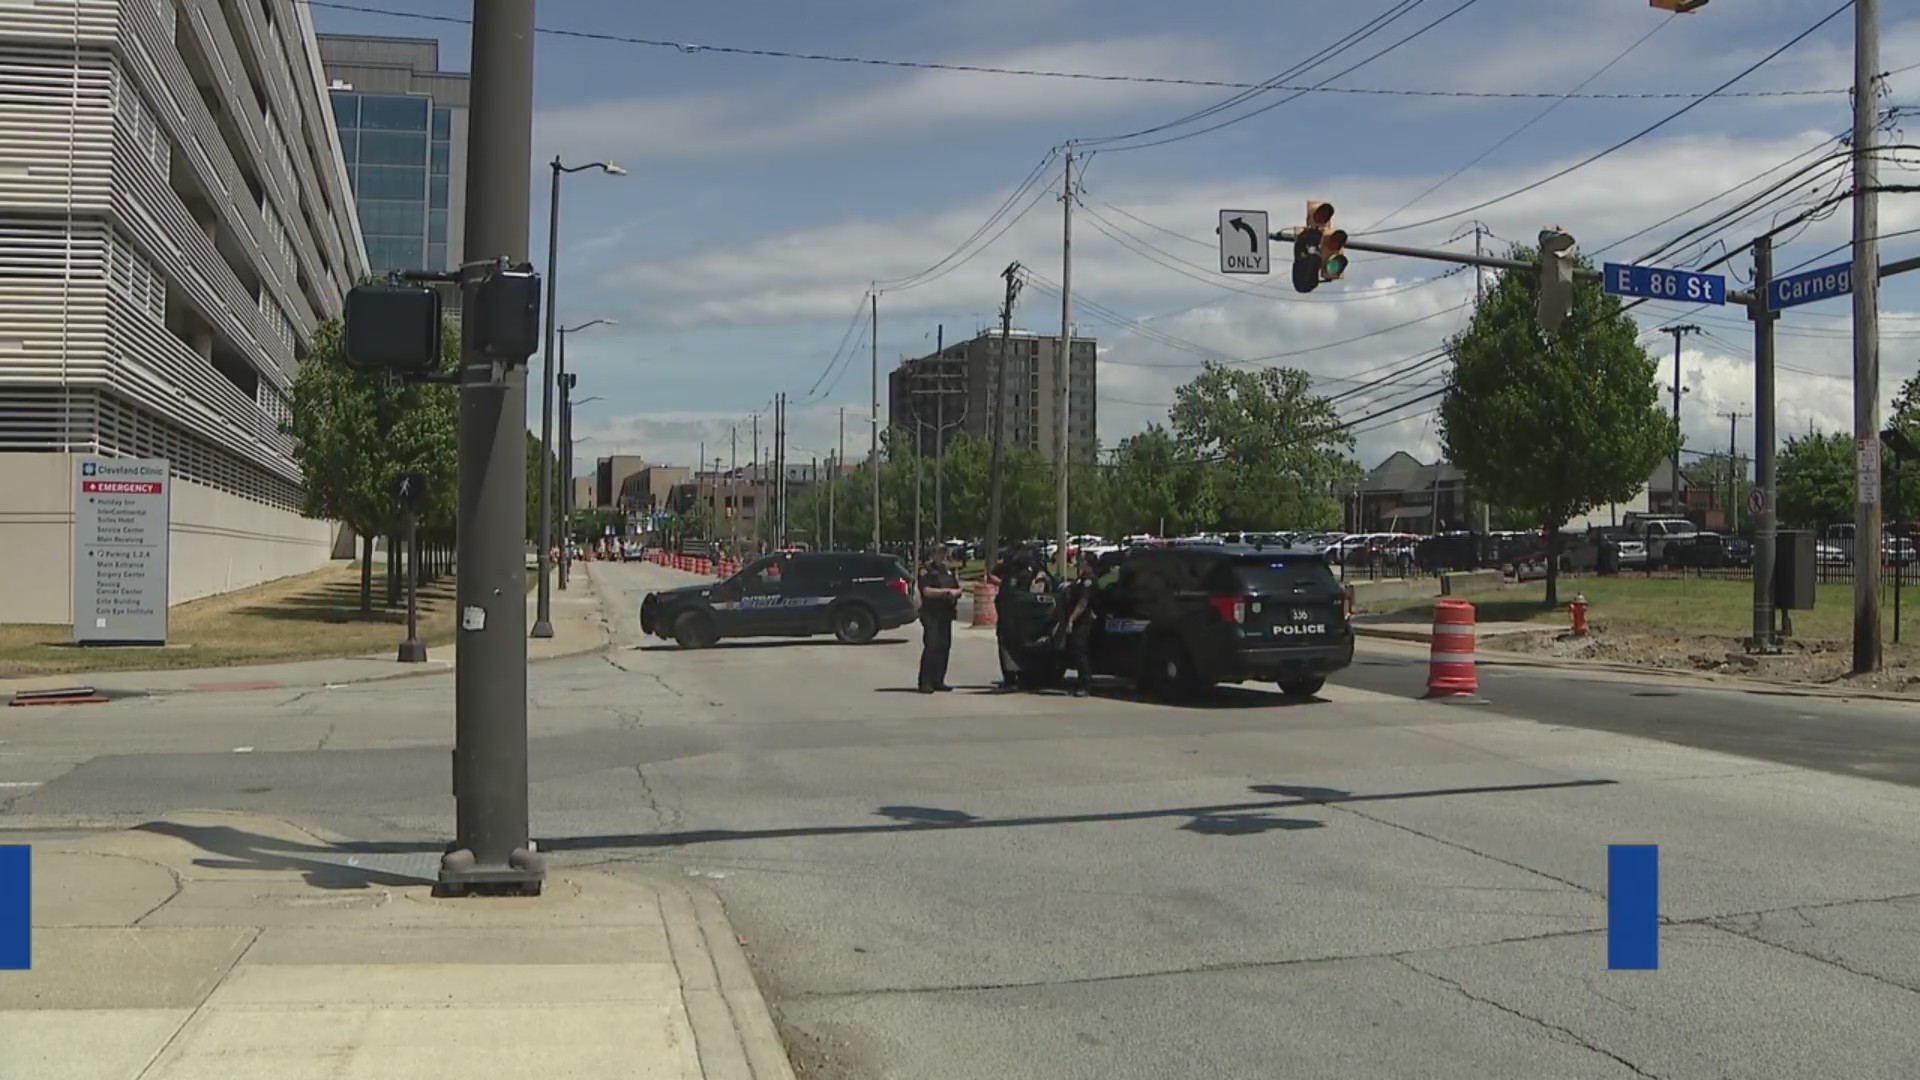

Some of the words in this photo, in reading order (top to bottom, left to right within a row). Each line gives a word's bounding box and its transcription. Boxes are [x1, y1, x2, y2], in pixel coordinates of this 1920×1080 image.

[1228, 255, 1262, 268] ONLY
[1619, 269, 1639, 292] E.
[1650, 273, 1676, 296] 86
[1687, 277, 1712, 299] St
[98, 465, 139, 475] Cleveland
[140, 467, 163, 476] Clinic
[98, 483, 154, 493] EMERGENCY
[1273, 624, 1325, 635] POLICE
